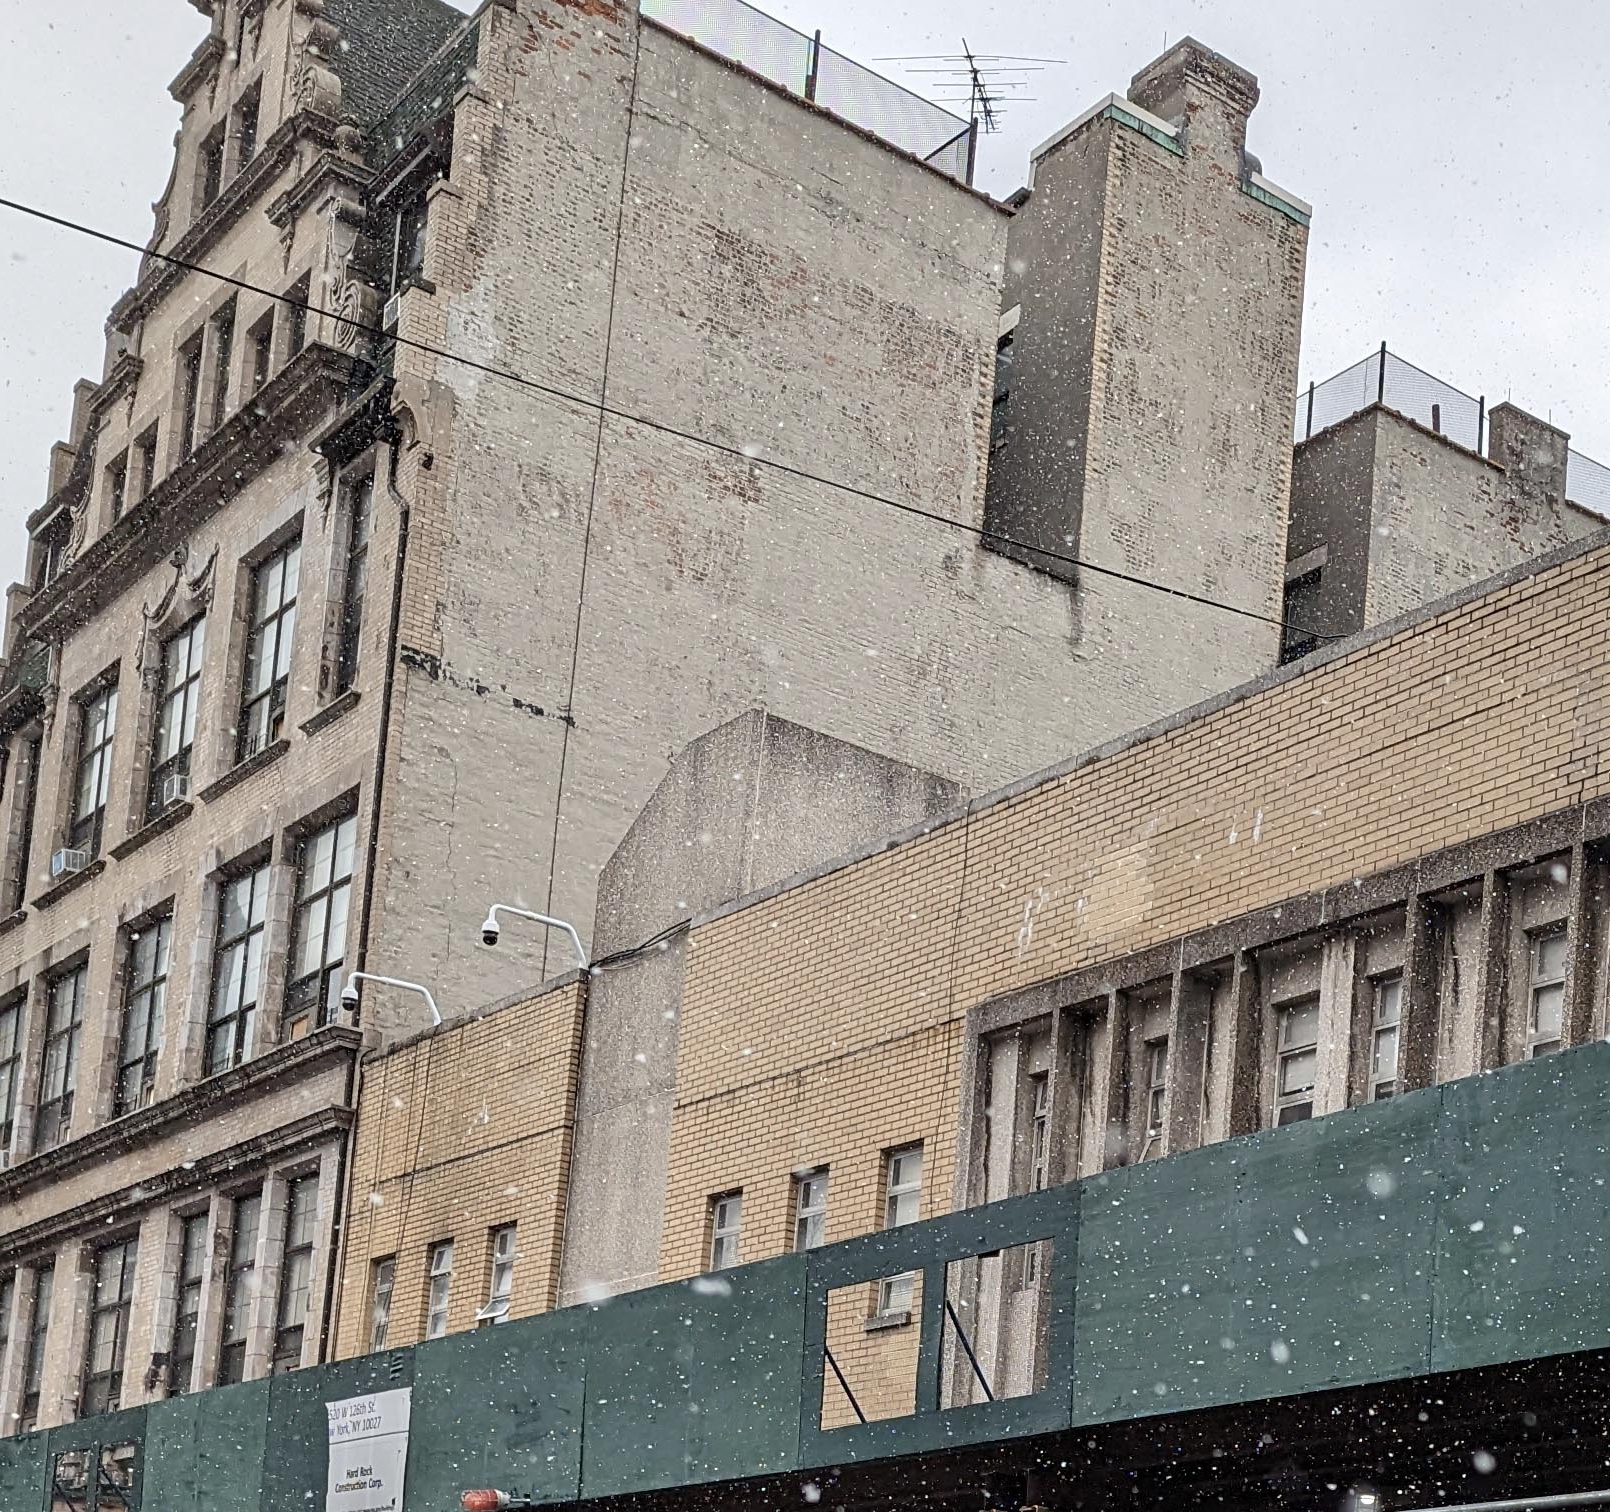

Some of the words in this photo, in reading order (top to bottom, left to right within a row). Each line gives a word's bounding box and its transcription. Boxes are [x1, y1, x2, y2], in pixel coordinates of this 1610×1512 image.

[362, 1416, 382, 1431] 10027
[346, 1467, 359, 1480] Hard
[360, 1465, 373, 1477] Rock
[335, 1480, 367, 1494] Construction
[368, 1477, 383, 1491] Corp.
